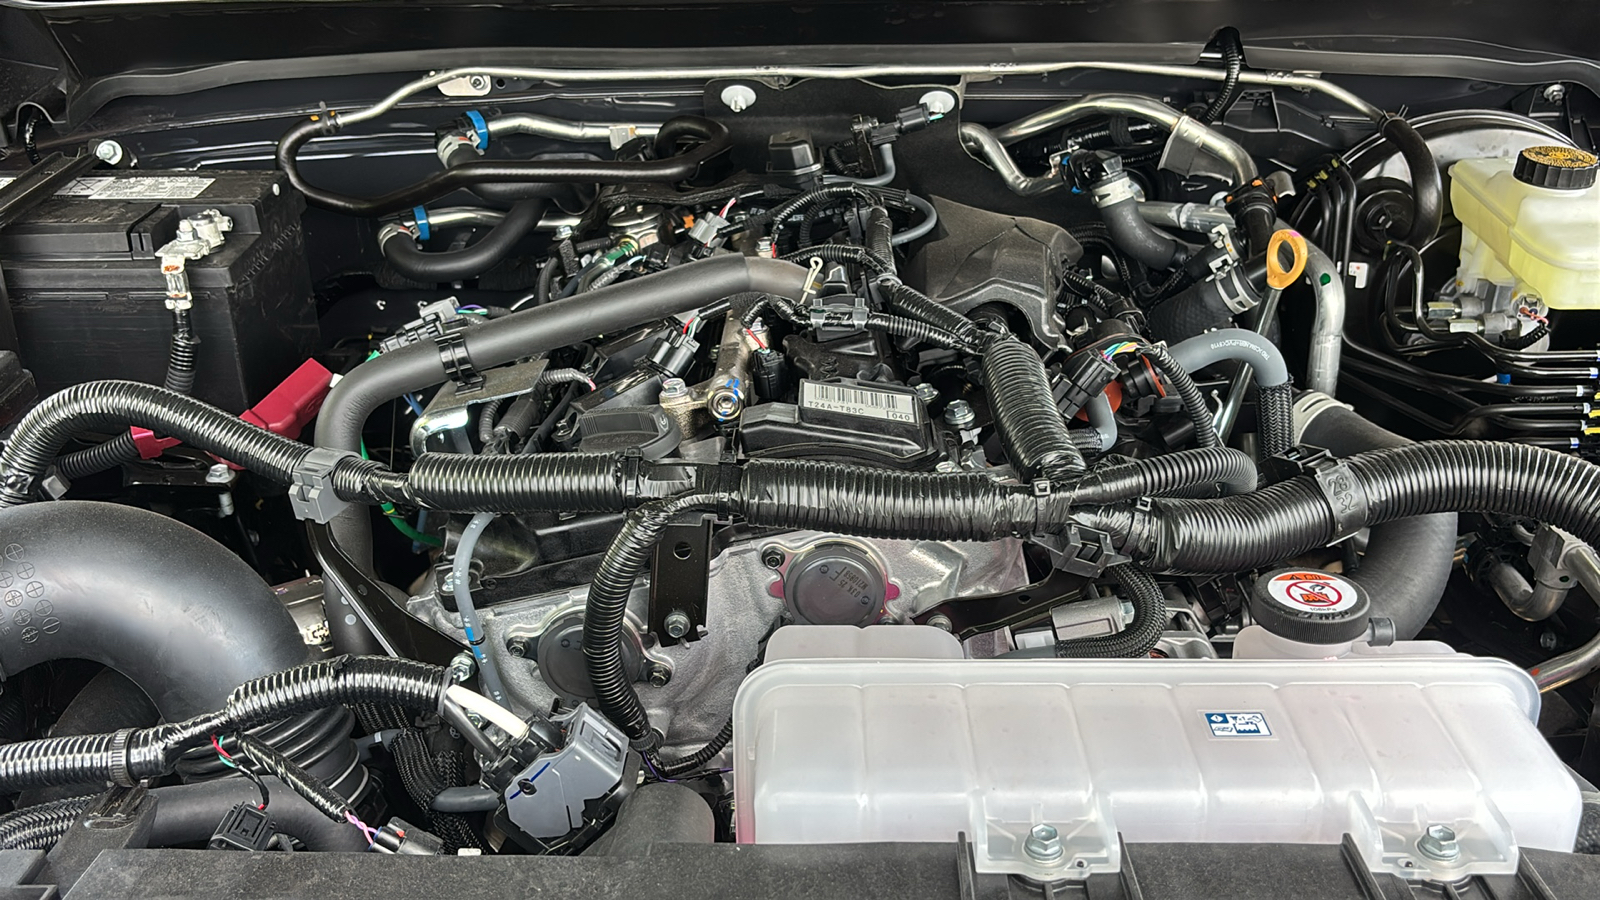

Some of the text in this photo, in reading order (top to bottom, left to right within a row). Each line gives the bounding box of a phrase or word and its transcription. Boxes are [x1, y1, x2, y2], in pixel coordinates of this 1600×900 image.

[807, 400, 865, 415] T24A-T83C
[891, 412, 911, 421] 040
[1336, 492, 1358, 514] 32
